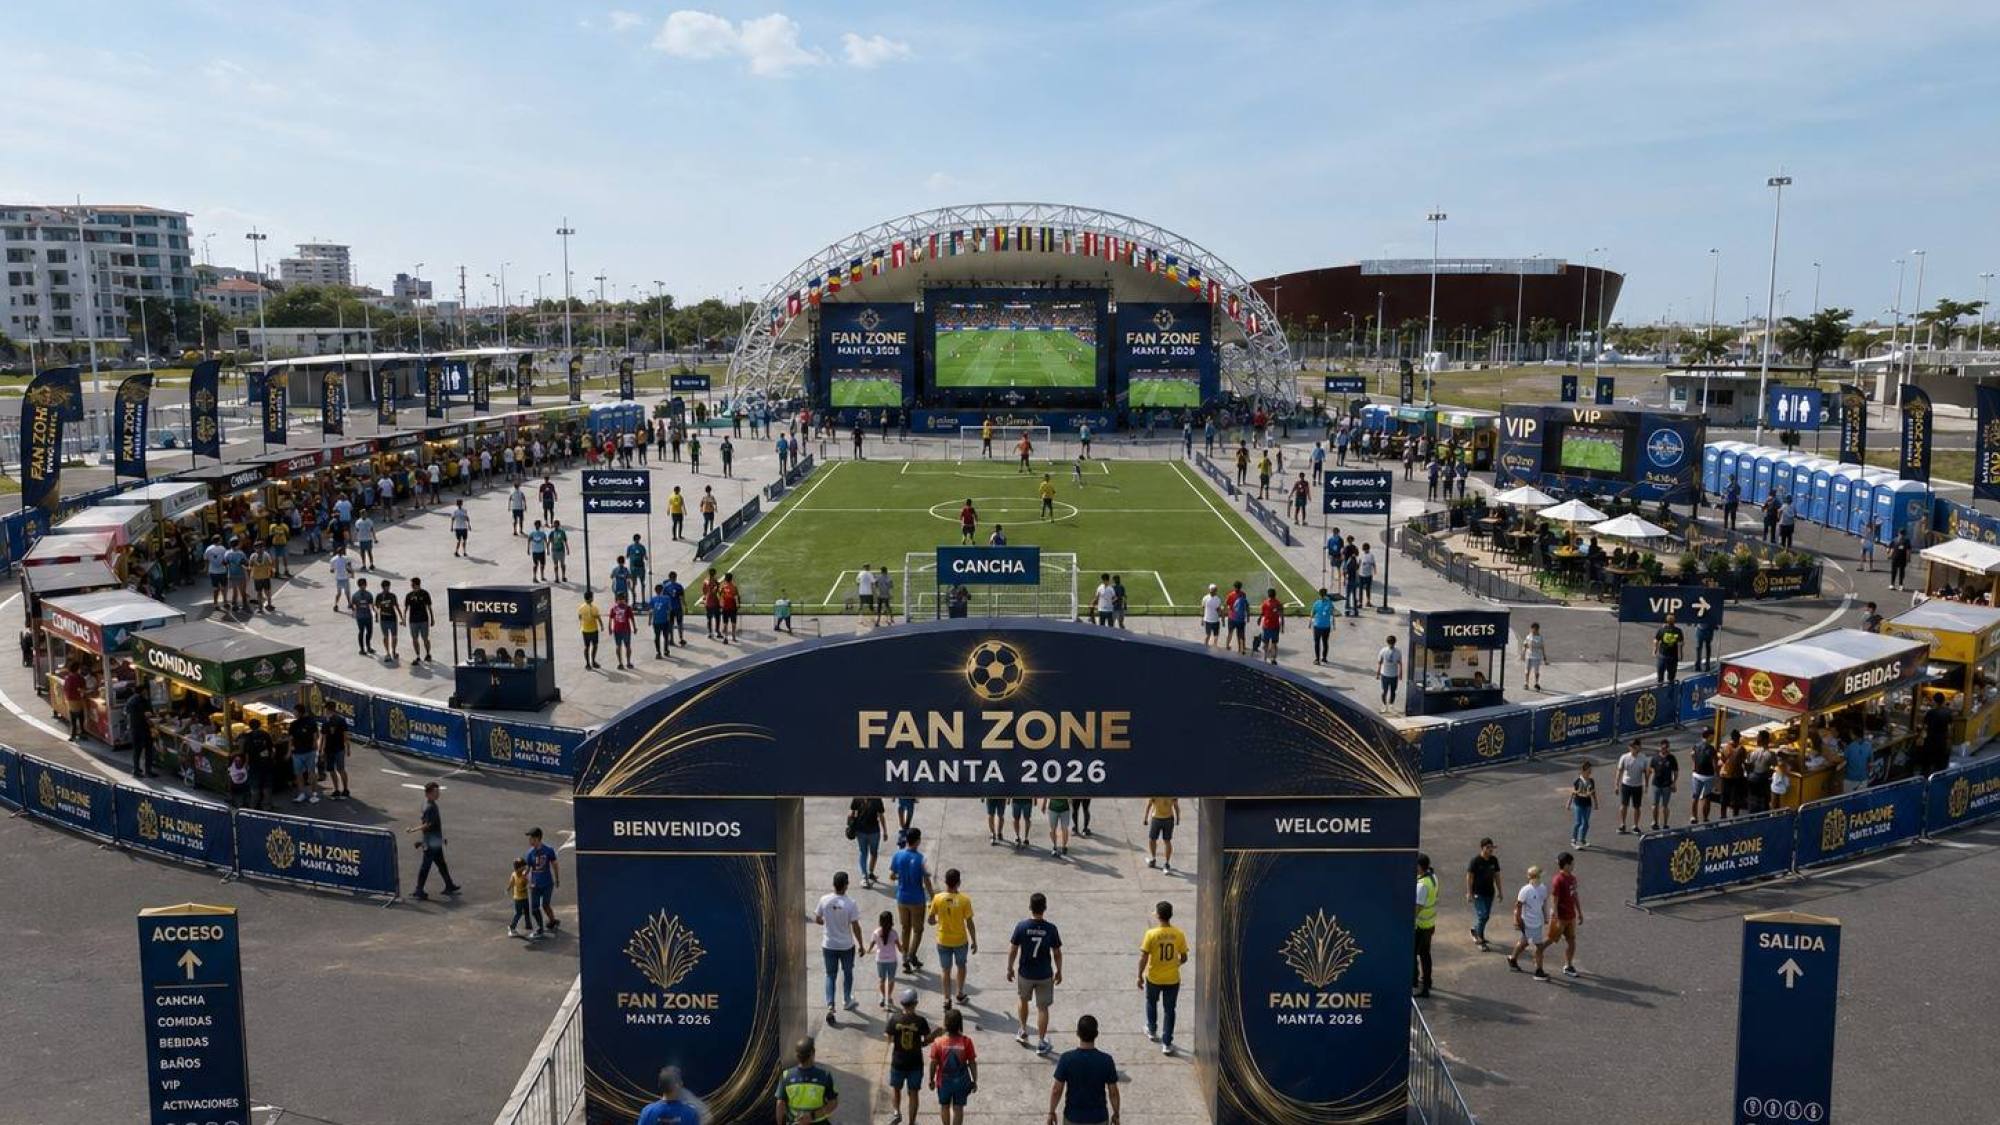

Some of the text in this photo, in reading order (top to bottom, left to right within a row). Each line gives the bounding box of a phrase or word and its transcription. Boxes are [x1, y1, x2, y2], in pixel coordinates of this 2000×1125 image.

[831, 332, 907, 344] FAN ZONE
[1126, 332, 1201, 344] FAN ZONE
[1573, 408, 1601, 424] VIP
[1505, 416, 1537, 438] VIP
[952, 559, 1026, 573] CANCHA
[463, 600, 519, 614] TICKETS
[1648, 597, 1683, 614] VIP
[1442, 624, 1496, 637] TICKETS
[148, 648, 203, 682] COMIDAS
[1843, 660, 1902, 695] BEBIDAS
[858, 710, 1132, 750] FAN ZONE
[885, 759, 1107, 784] MANTA 2026
[613, 821, 741, 837] BIENVENIDOS
[1275, 818, 1371, 833] WELCOME
[325, 845, 361, 866] ZONE
[1705, 836, 1764, 863] FAN ZONE
[152, 926, 224, 942] ACCESO
[1031, 937, 1042, 958] 7
[1759, 932, 1826, 952] SALIDA
[1159, 943, 1175, 961] 10
[156, 995, 206, 1006] CANCHA
[617, 993, 719, 1009] FAN ZONE
[1269, 993, 1372, 1008] FAN ZONE
[157, 1015, 213, 1027] COMIDAS
[626, 1014, 711, 1025] MANTA 2026
[1277, 1014, 1363, 1025] MANTA 2026
[159, 1036, 209, 1048] BEBIDAS
[160, 1056, 201, 1069] BAÑOS
[162, 1080, 181, 1090] VIP
[163, 1098, 239, 1110] ACTIVACIONES
